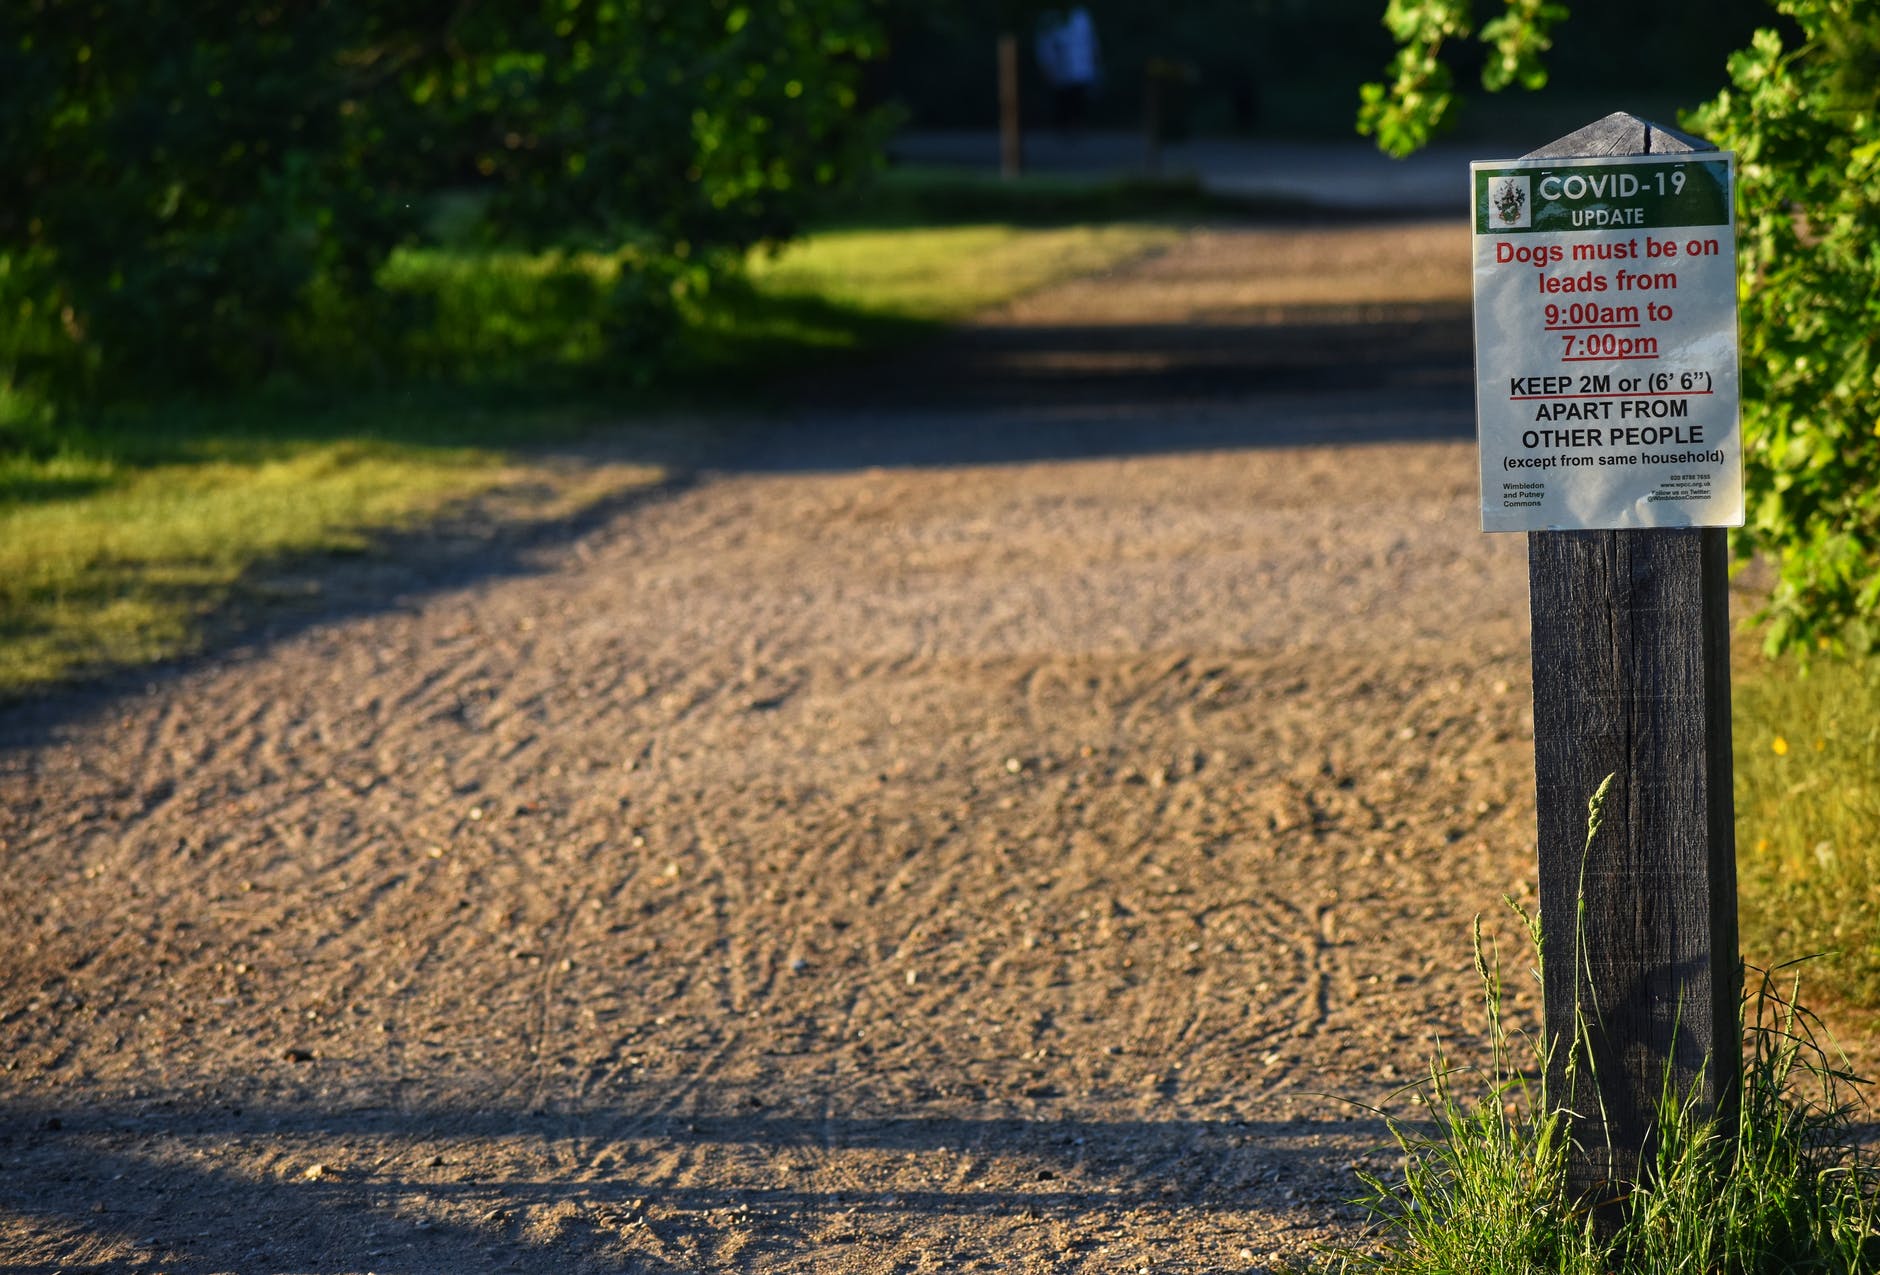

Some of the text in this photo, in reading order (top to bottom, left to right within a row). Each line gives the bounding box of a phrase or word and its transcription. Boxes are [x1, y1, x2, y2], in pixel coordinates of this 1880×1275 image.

[1539, 171, 1687, 201] COVID-19
[1571, 208, 1645, 227] UPDATE
[1496, 236, 1720, 268] Dogs must be on
[1539, 269, 1678, 294] leads from
[1544, 301, 1674, 326] 9:00am to
[1561, 334, 1659, 359] 7:00pm
[1510, 375, 1573, 396] KEEP
[1579, 374, 1611, 394] 2M
[1618, 377, 1642, 392] or
[1535, 399, 1689, 422] APART FROM
[1522, 425, 1705, 449] OTHER PEOPLE
[1503, 450, 1725, 471] (except from same household)
[1503, 482, 1545, 490] Wimbledon
[1519, 491, 1545, 500] Putney
